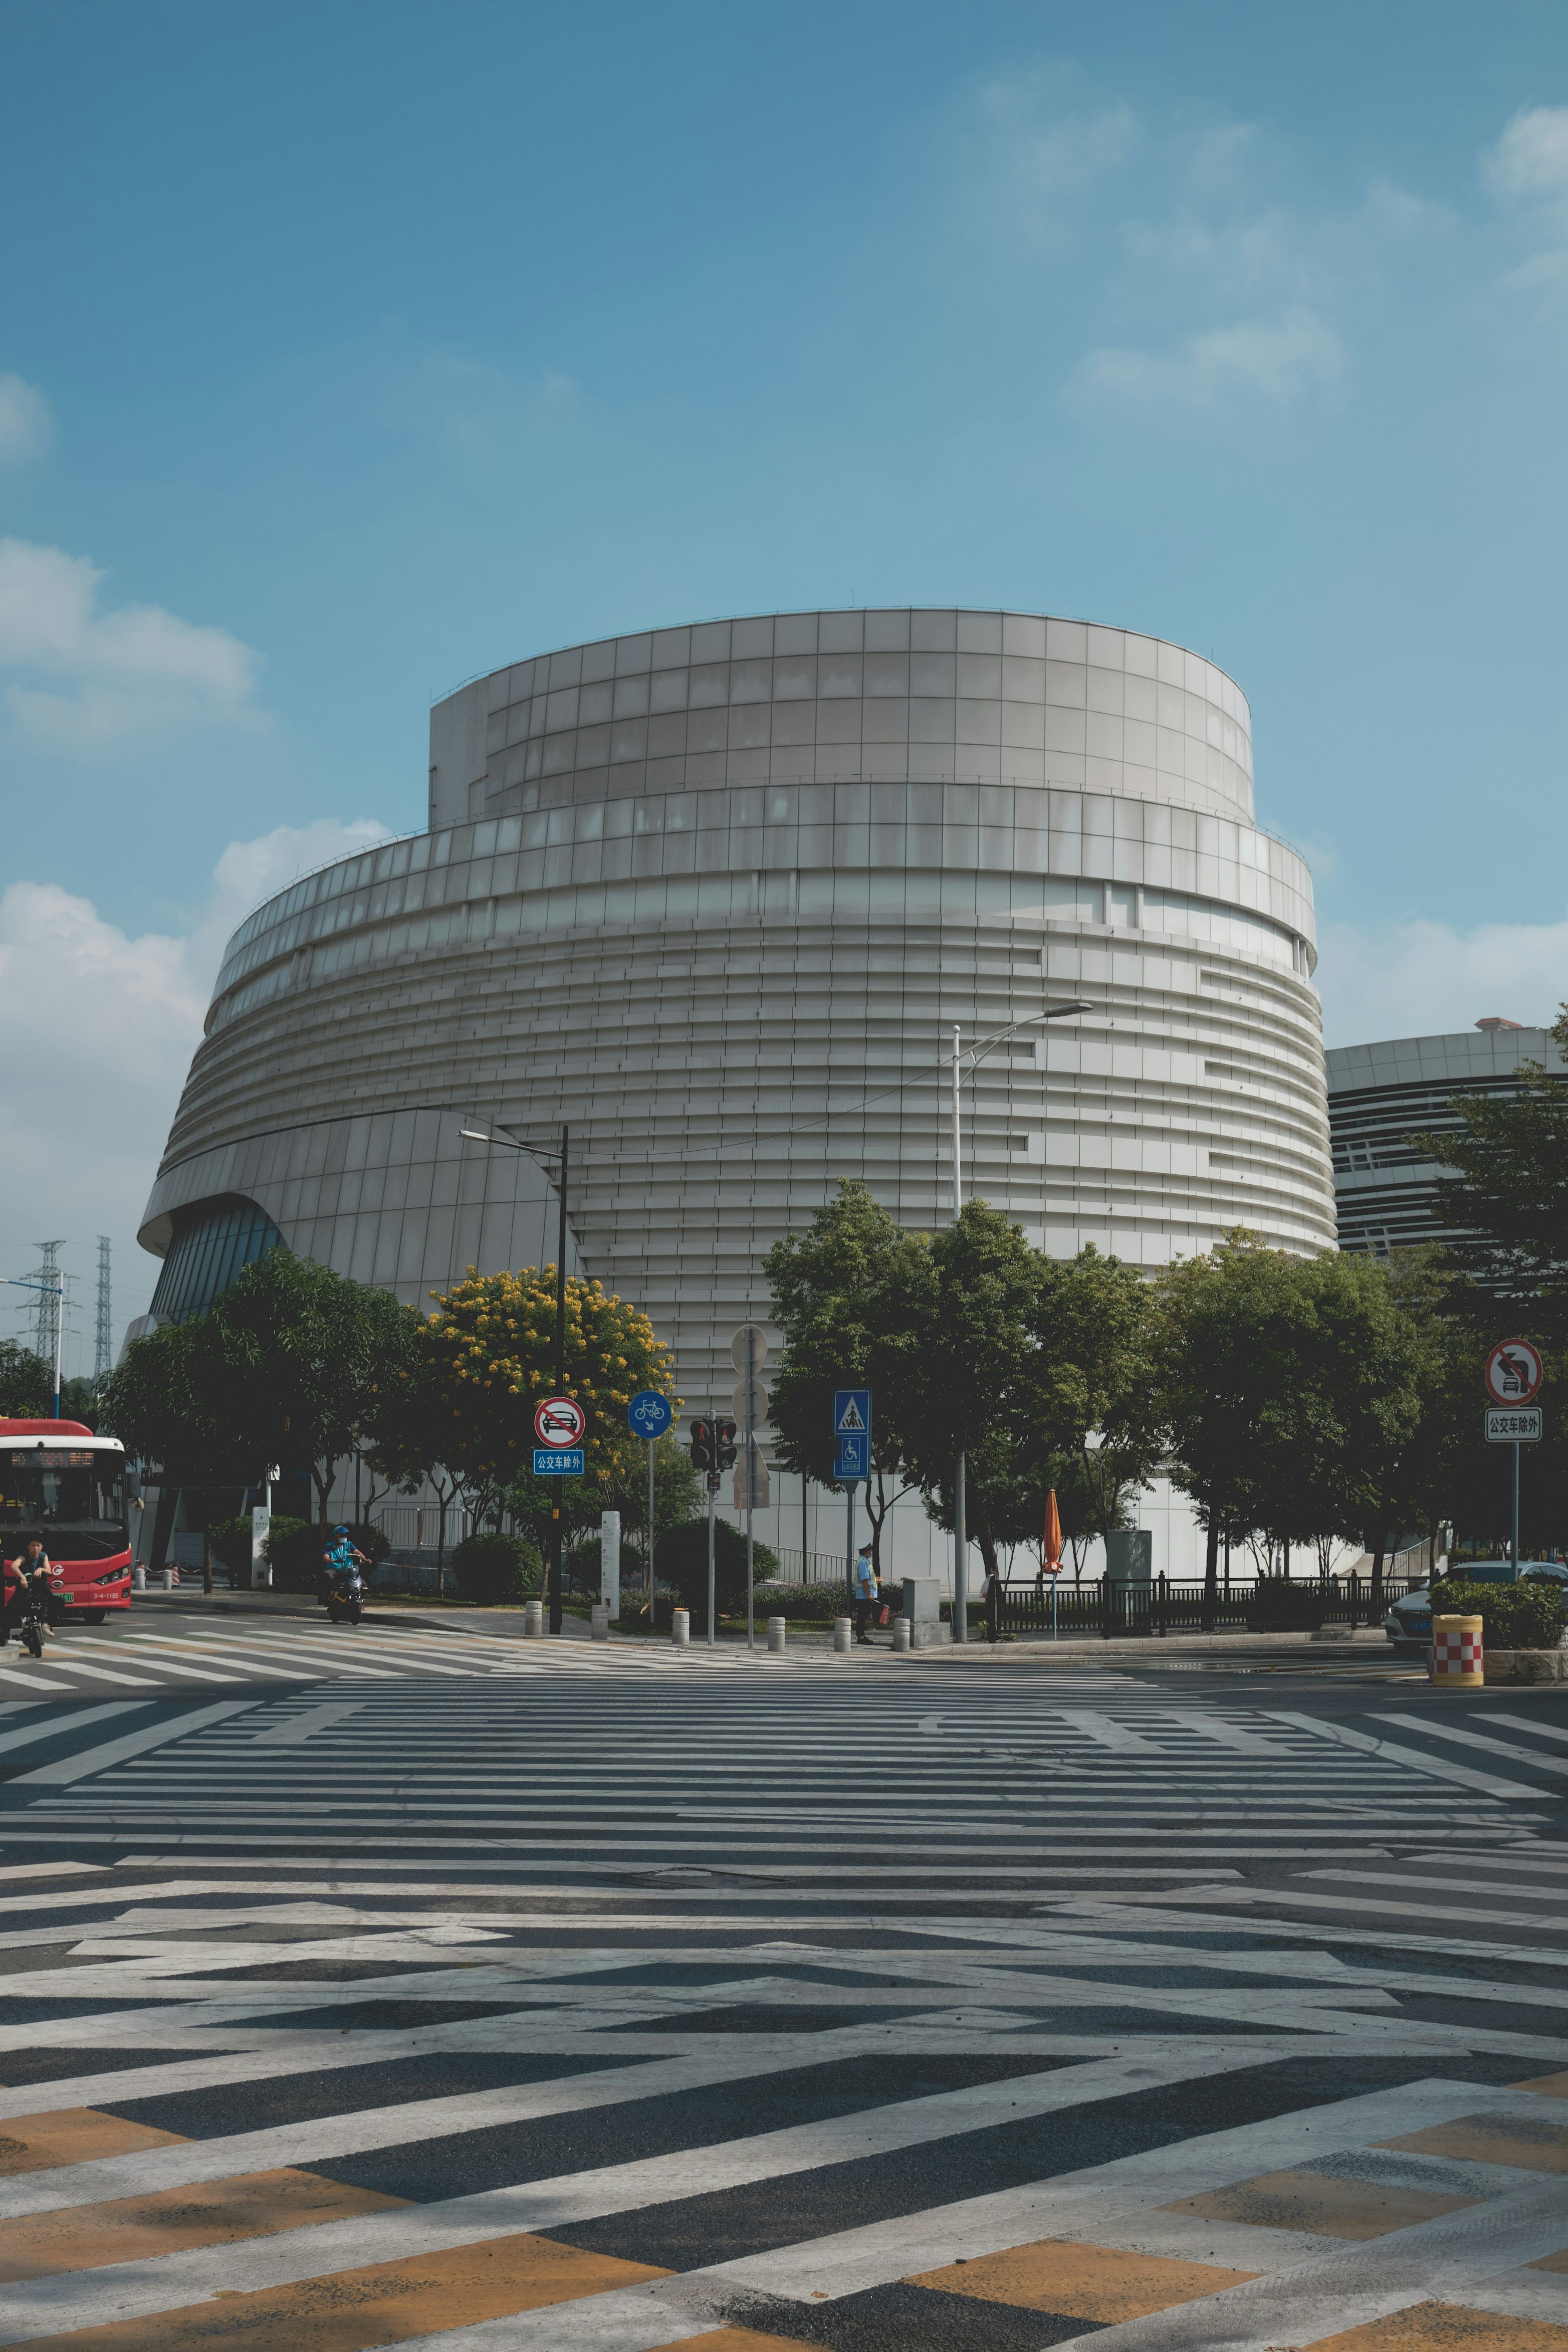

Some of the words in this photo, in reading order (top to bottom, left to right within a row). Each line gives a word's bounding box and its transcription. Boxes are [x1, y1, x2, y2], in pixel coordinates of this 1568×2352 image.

[1490, 1416, 1537, 1433] 公交车除外
[538, 1455, 580, 1469] 公交车除外
